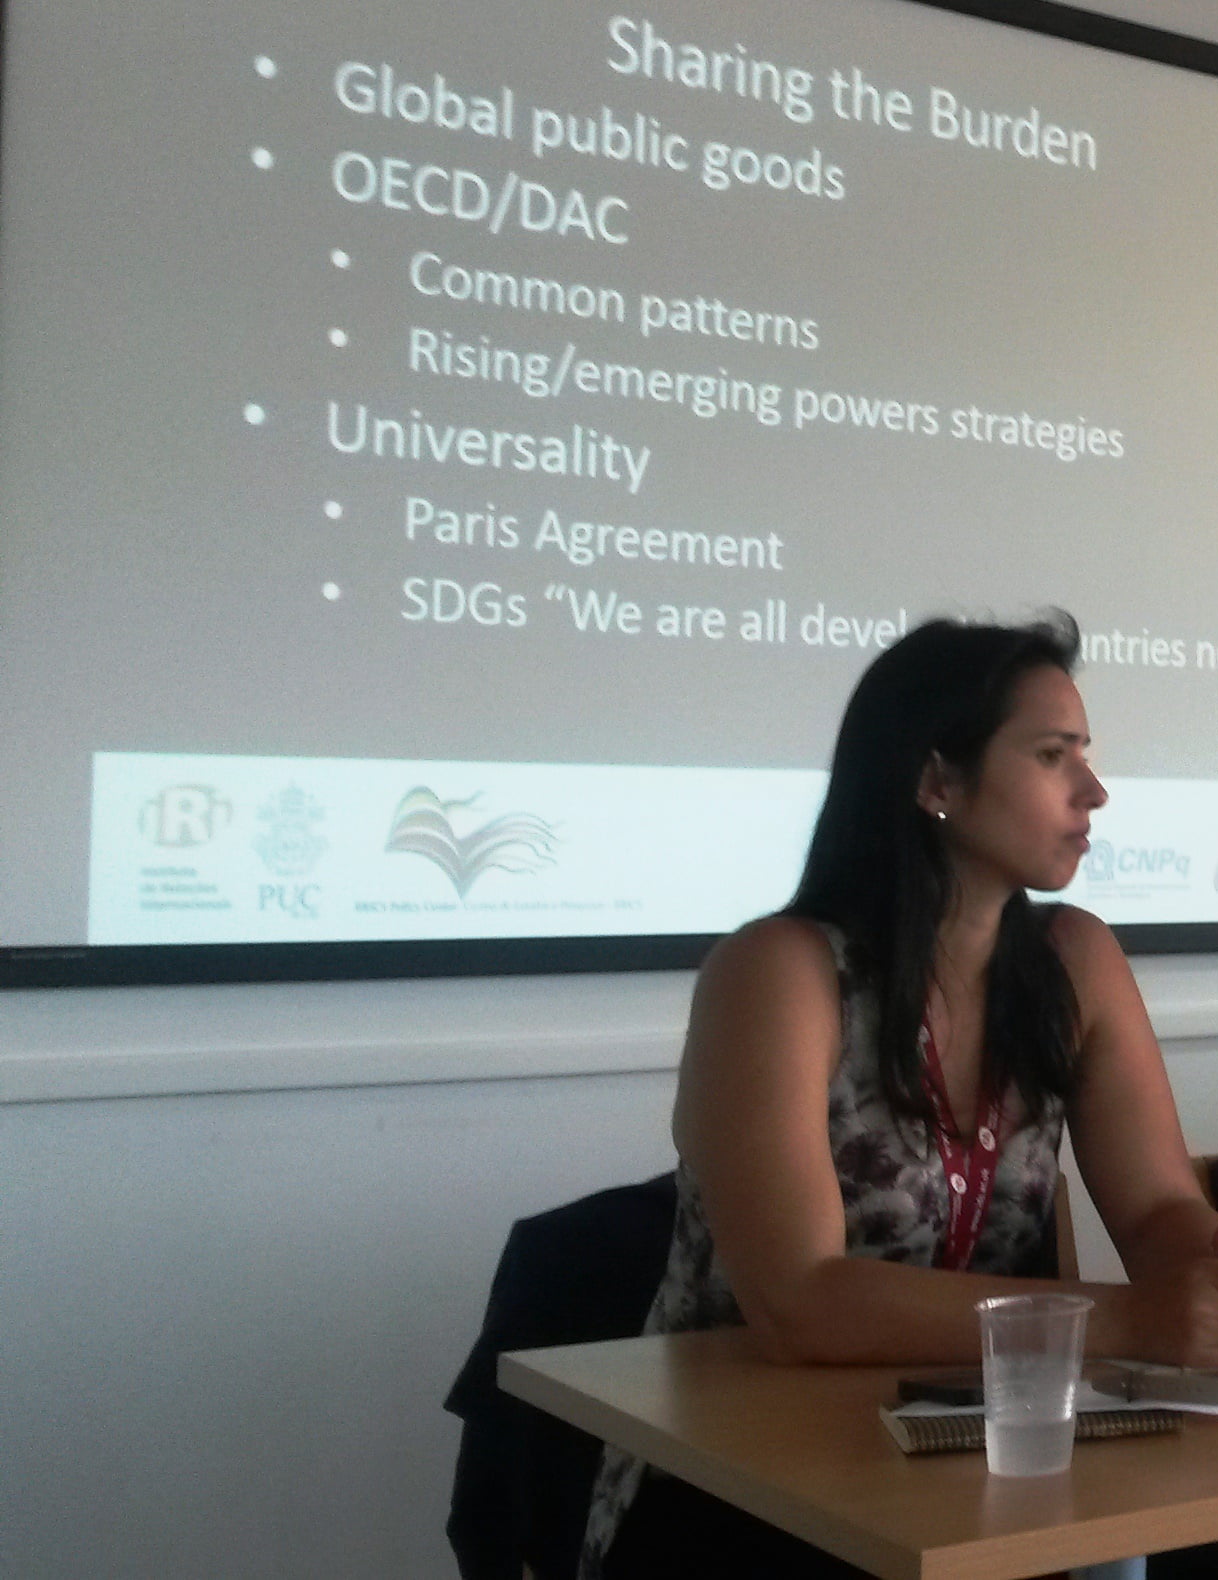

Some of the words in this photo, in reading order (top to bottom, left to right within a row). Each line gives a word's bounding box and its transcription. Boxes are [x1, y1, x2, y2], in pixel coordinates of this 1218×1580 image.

[335, 62, 514, 139] Global
[533, 106, 688, 171] public
[702, 142, 845, 200] goods
[608, 16, 814, 128] Sharing
[829, 66, 913, 131] the
[930, 87, 1096, 170] Burden
[332, 151, 628, 244] OECD/DAC
[410, 252, 624, 321] Common
[641, 296, 819, 349] patterns
[410, 328, 782, 426] Rising/emerging
[795, 389, 939, 435] powers
[951, 404, 1124, 461] strategies
[328, 401, 650, 493] Universality
[406, 497, 519, 548] Paris
[535, 510, 783, 570] Agreement
[402, 577, 527, 626] SDGs
[657, 605, 725, 639] are
[740, 599, 786, 642] all
[801, 603, 906, 648] devel
[256, 882, 322, 912] PUC
[1117, 847, 1191, 878] CNPq
